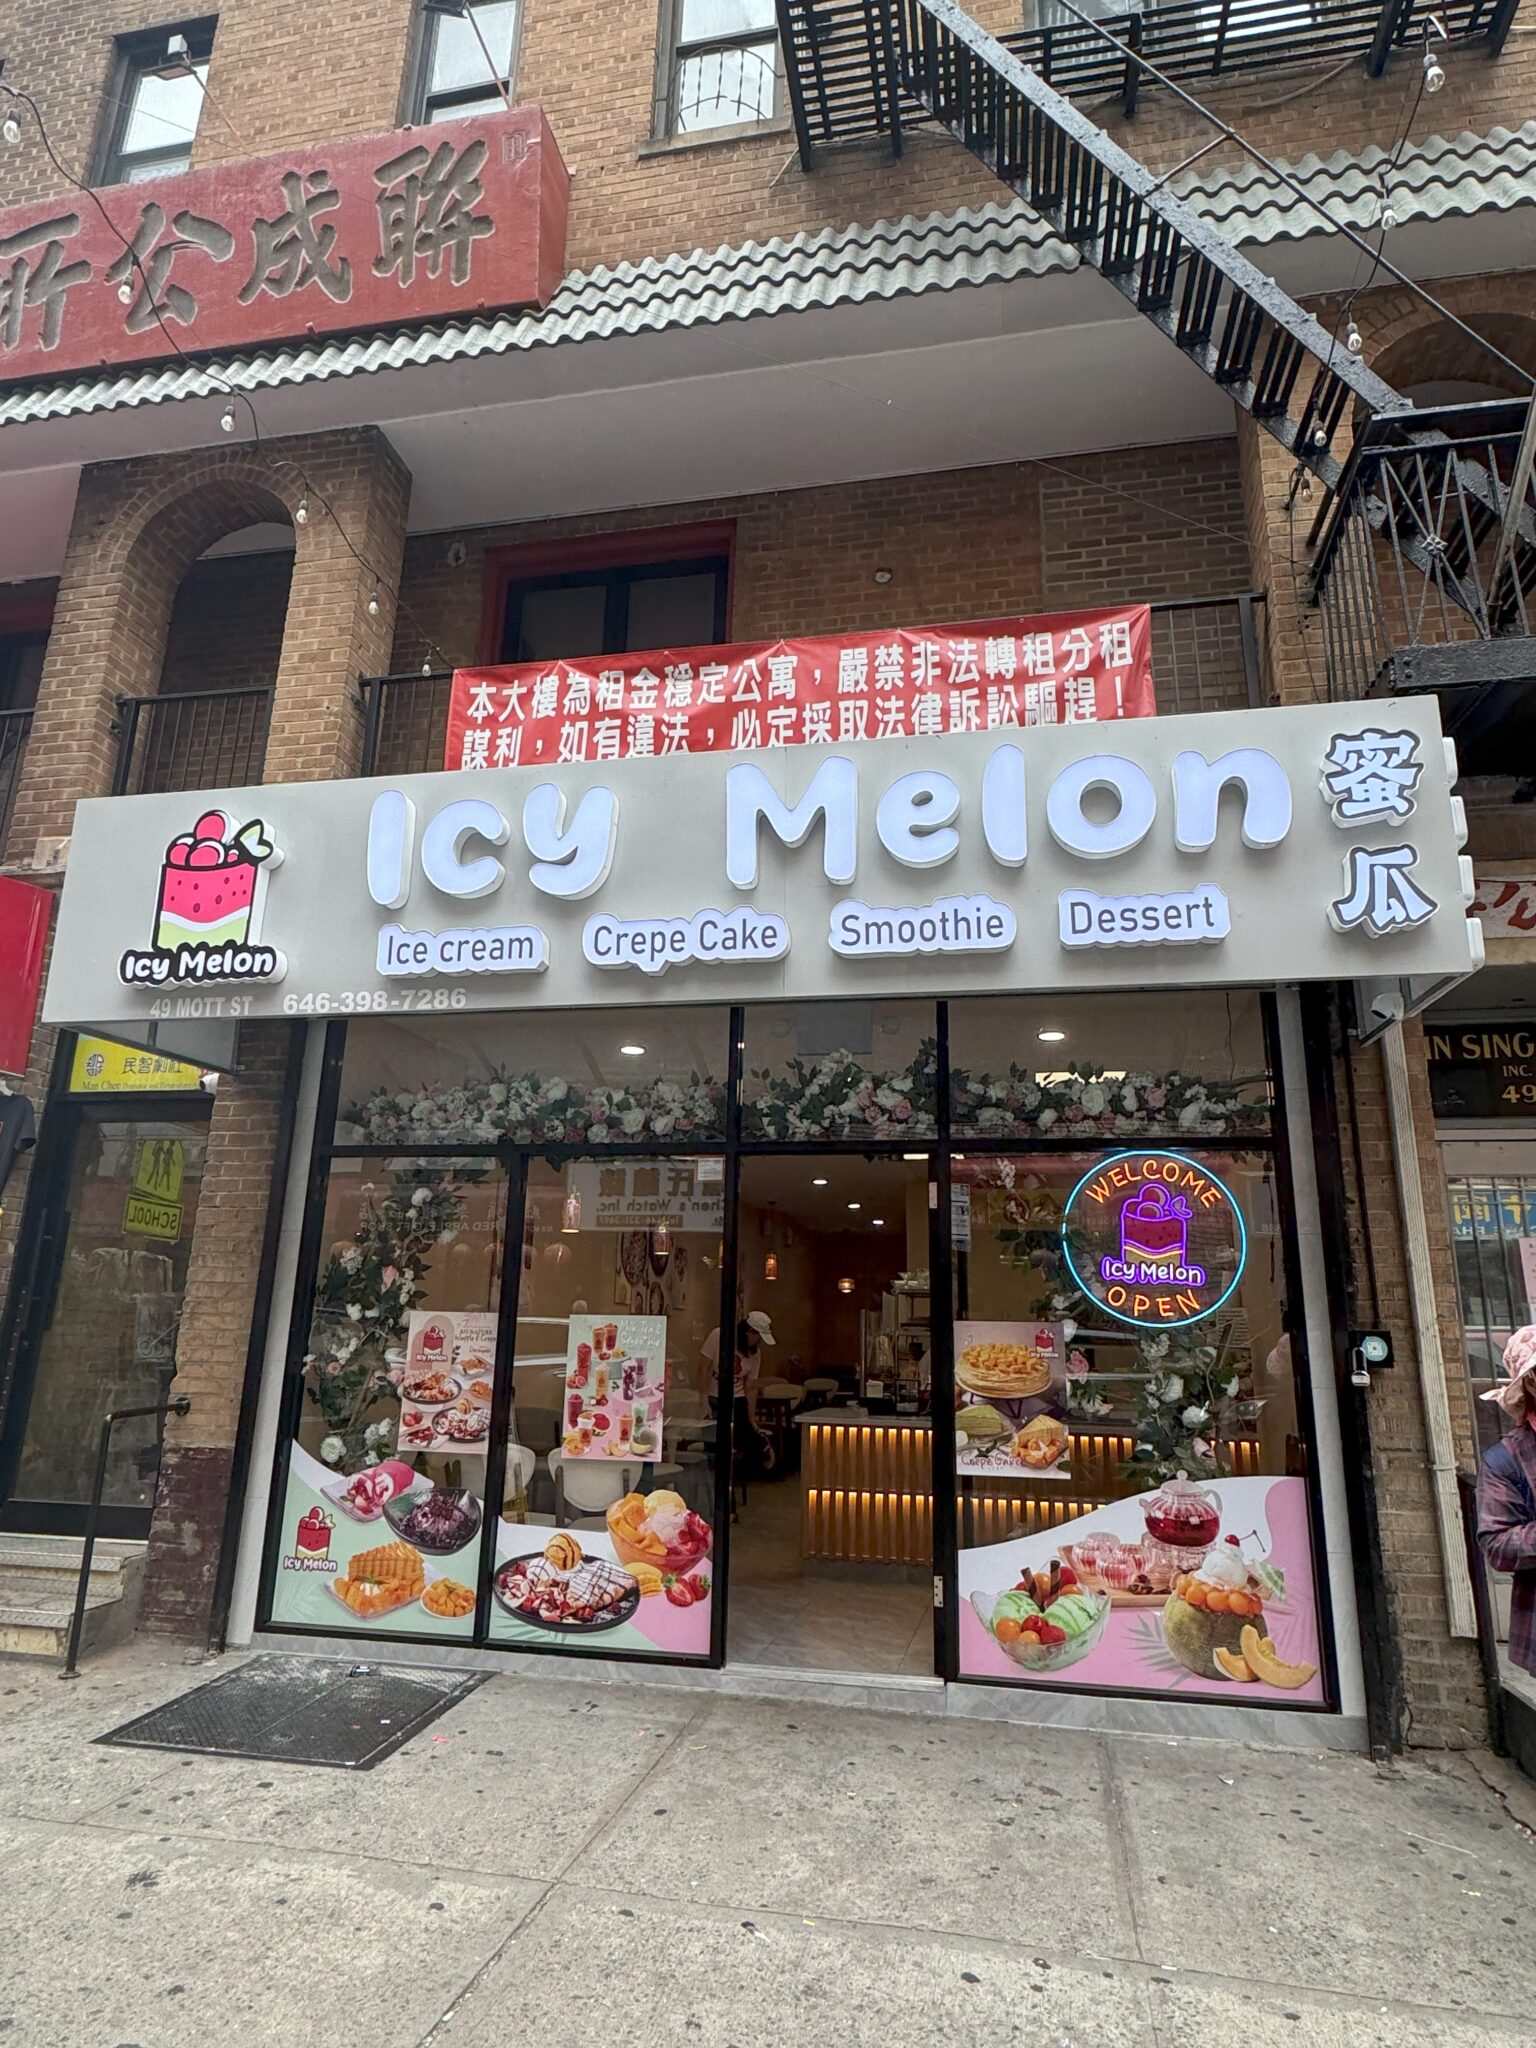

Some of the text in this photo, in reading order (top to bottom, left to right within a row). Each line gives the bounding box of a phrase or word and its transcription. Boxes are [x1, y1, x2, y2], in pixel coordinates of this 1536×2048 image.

[366, 743, 1293, 910] Icy Melon
[1322, 728, 1439, 934] 蜜瓜
[840, 905, 1003, 947] Smoothie
[1070, 896, 1215, 935] Dessert
[387, 935, 535, 966] Ice cream
[593, 917, 779, 962] Crepe Cake
[126, 949, 276, 981] Icy Melon
[150, 995, 254, 1018] 49 MOTT ST
[283, 989, 468, 1015] 646-398-7286
[1461, 1032, 1535, 1060] SING
[1502, 1064, 1533, 1077] INC.
[1085, 1159, 1223, 1209] WELCOME
[1105, 1260, 1201, 1284] Icy Melon
[1107, 1286, 1201, 1317] OPEN
[284, 1556, 338, 1571] Icy Melon
